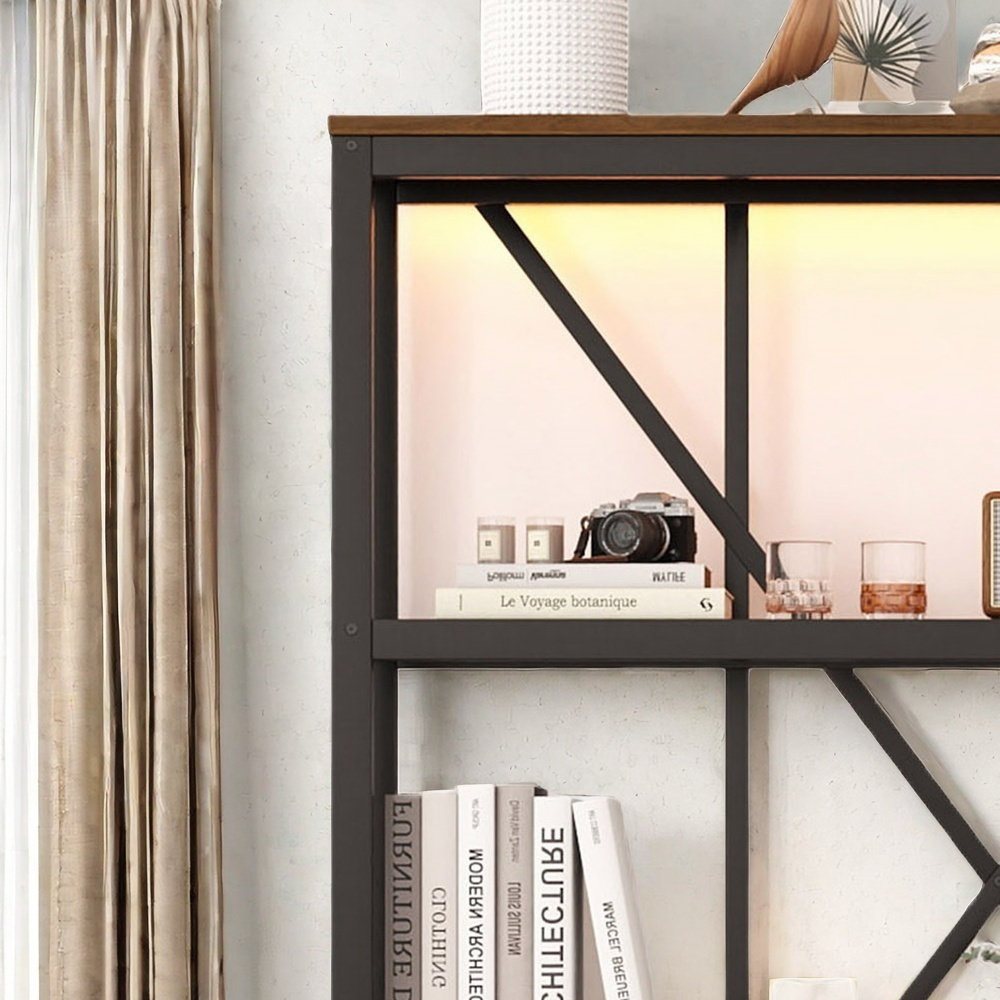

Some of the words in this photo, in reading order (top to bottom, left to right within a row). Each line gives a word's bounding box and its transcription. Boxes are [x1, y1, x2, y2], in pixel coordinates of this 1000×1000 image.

[500, 594, 515, 608] Le
[519, 594, 567, 611] Voyage
[571, 594, 637, 612] botanique
